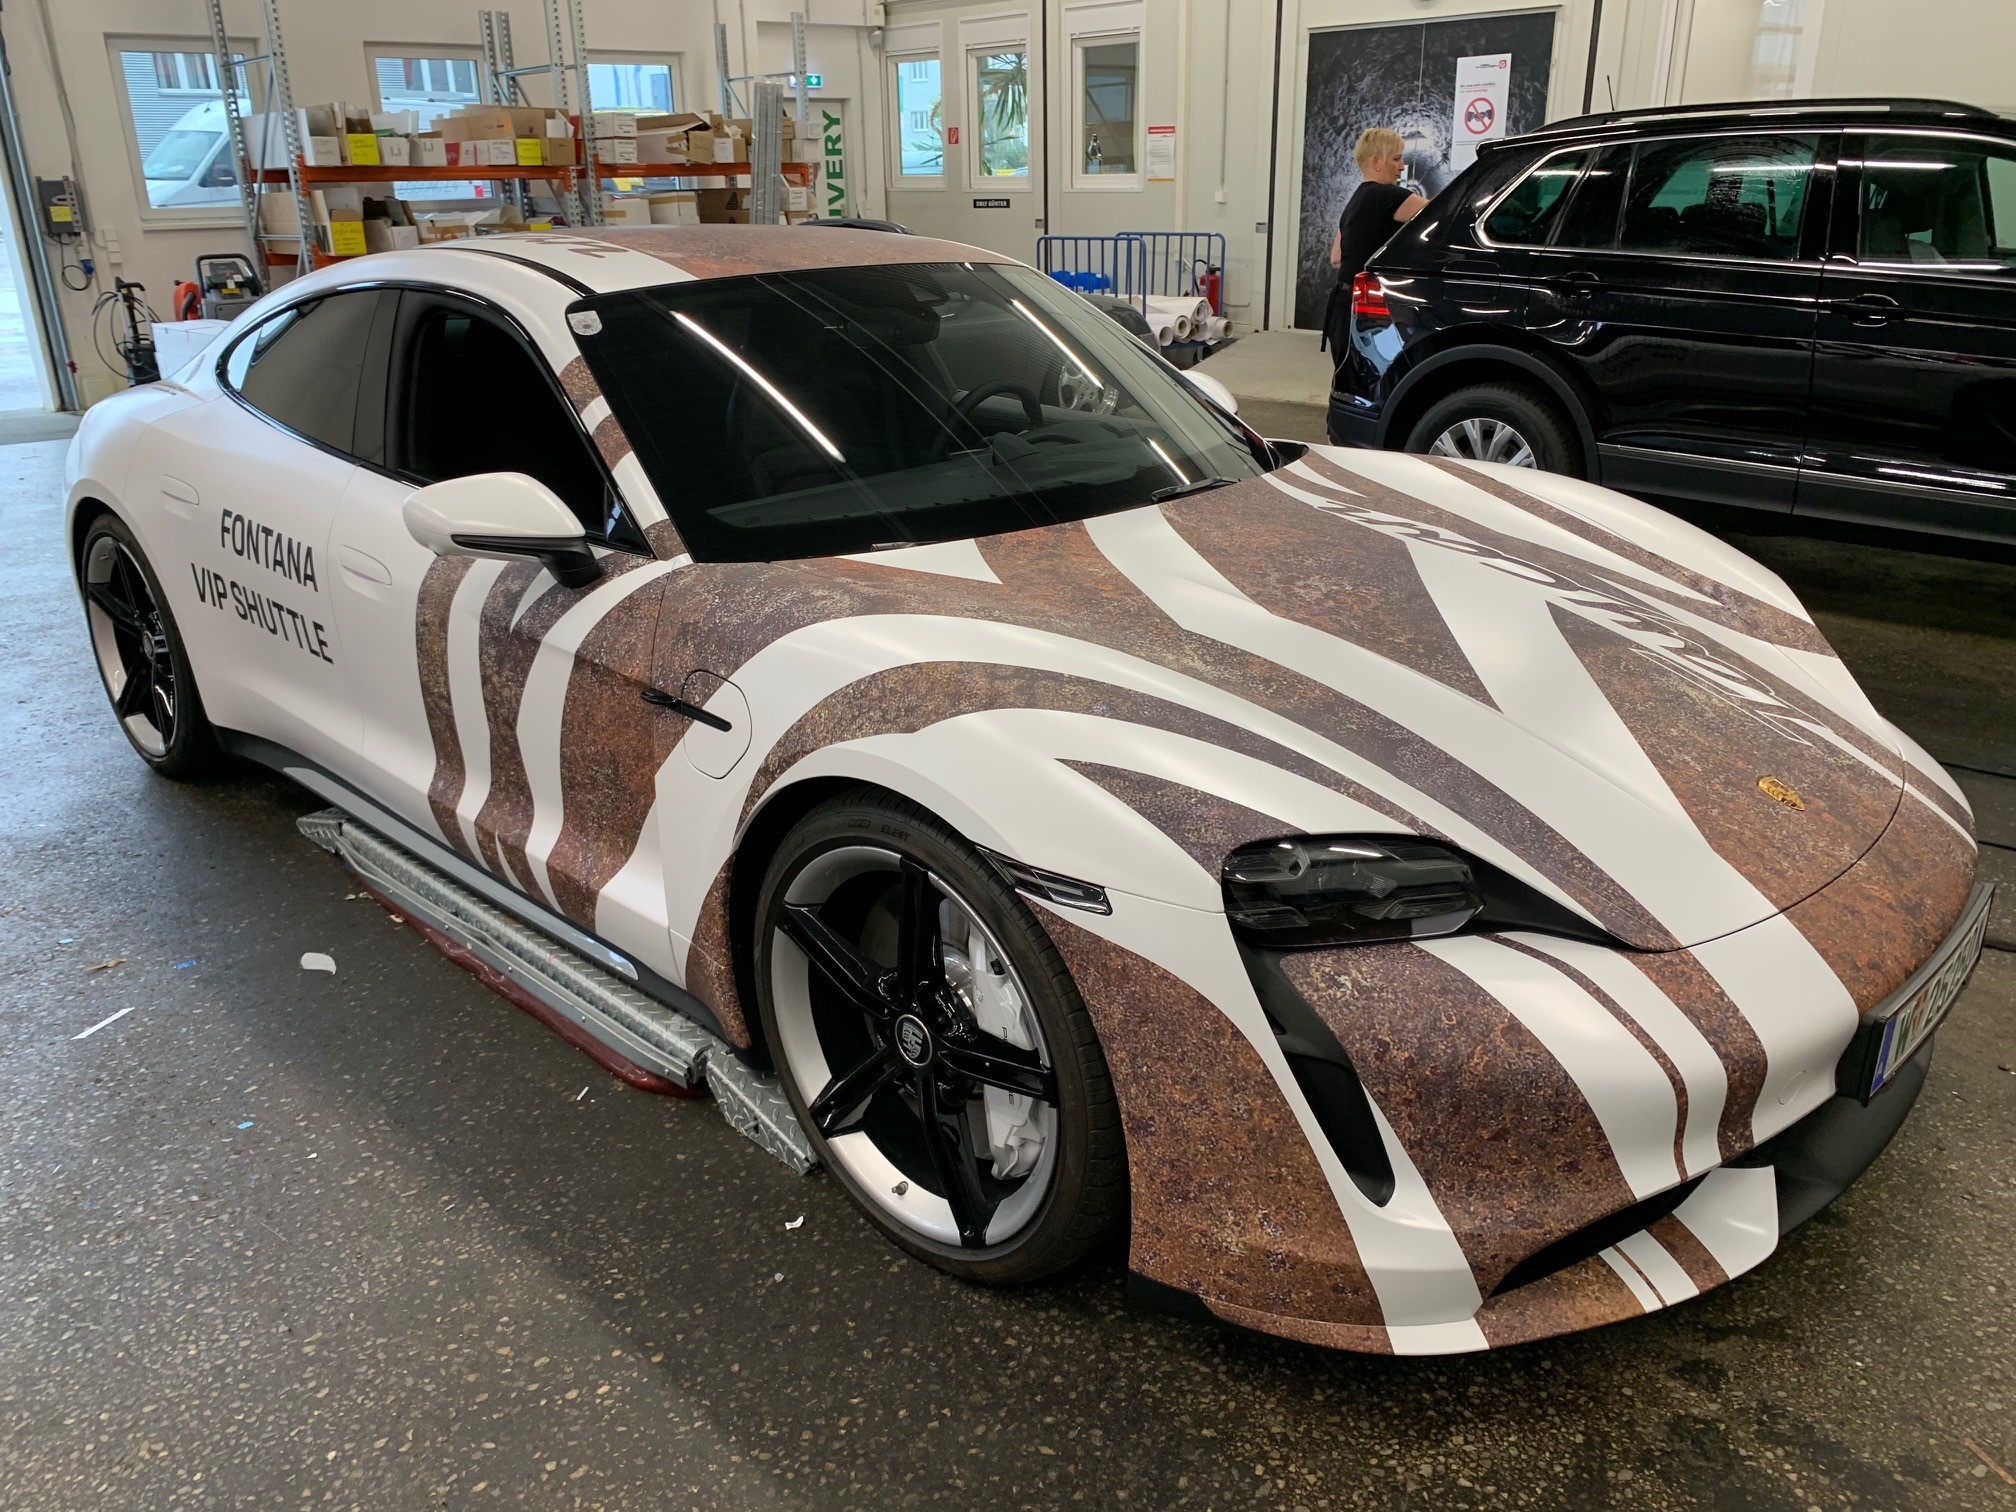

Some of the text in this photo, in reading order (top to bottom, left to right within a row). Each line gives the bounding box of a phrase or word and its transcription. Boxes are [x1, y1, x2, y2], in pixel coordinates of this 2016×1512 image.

[221, 508, 318, 593] FONTANA
[191, 562, 334, 665] VIP SHUTTLE
